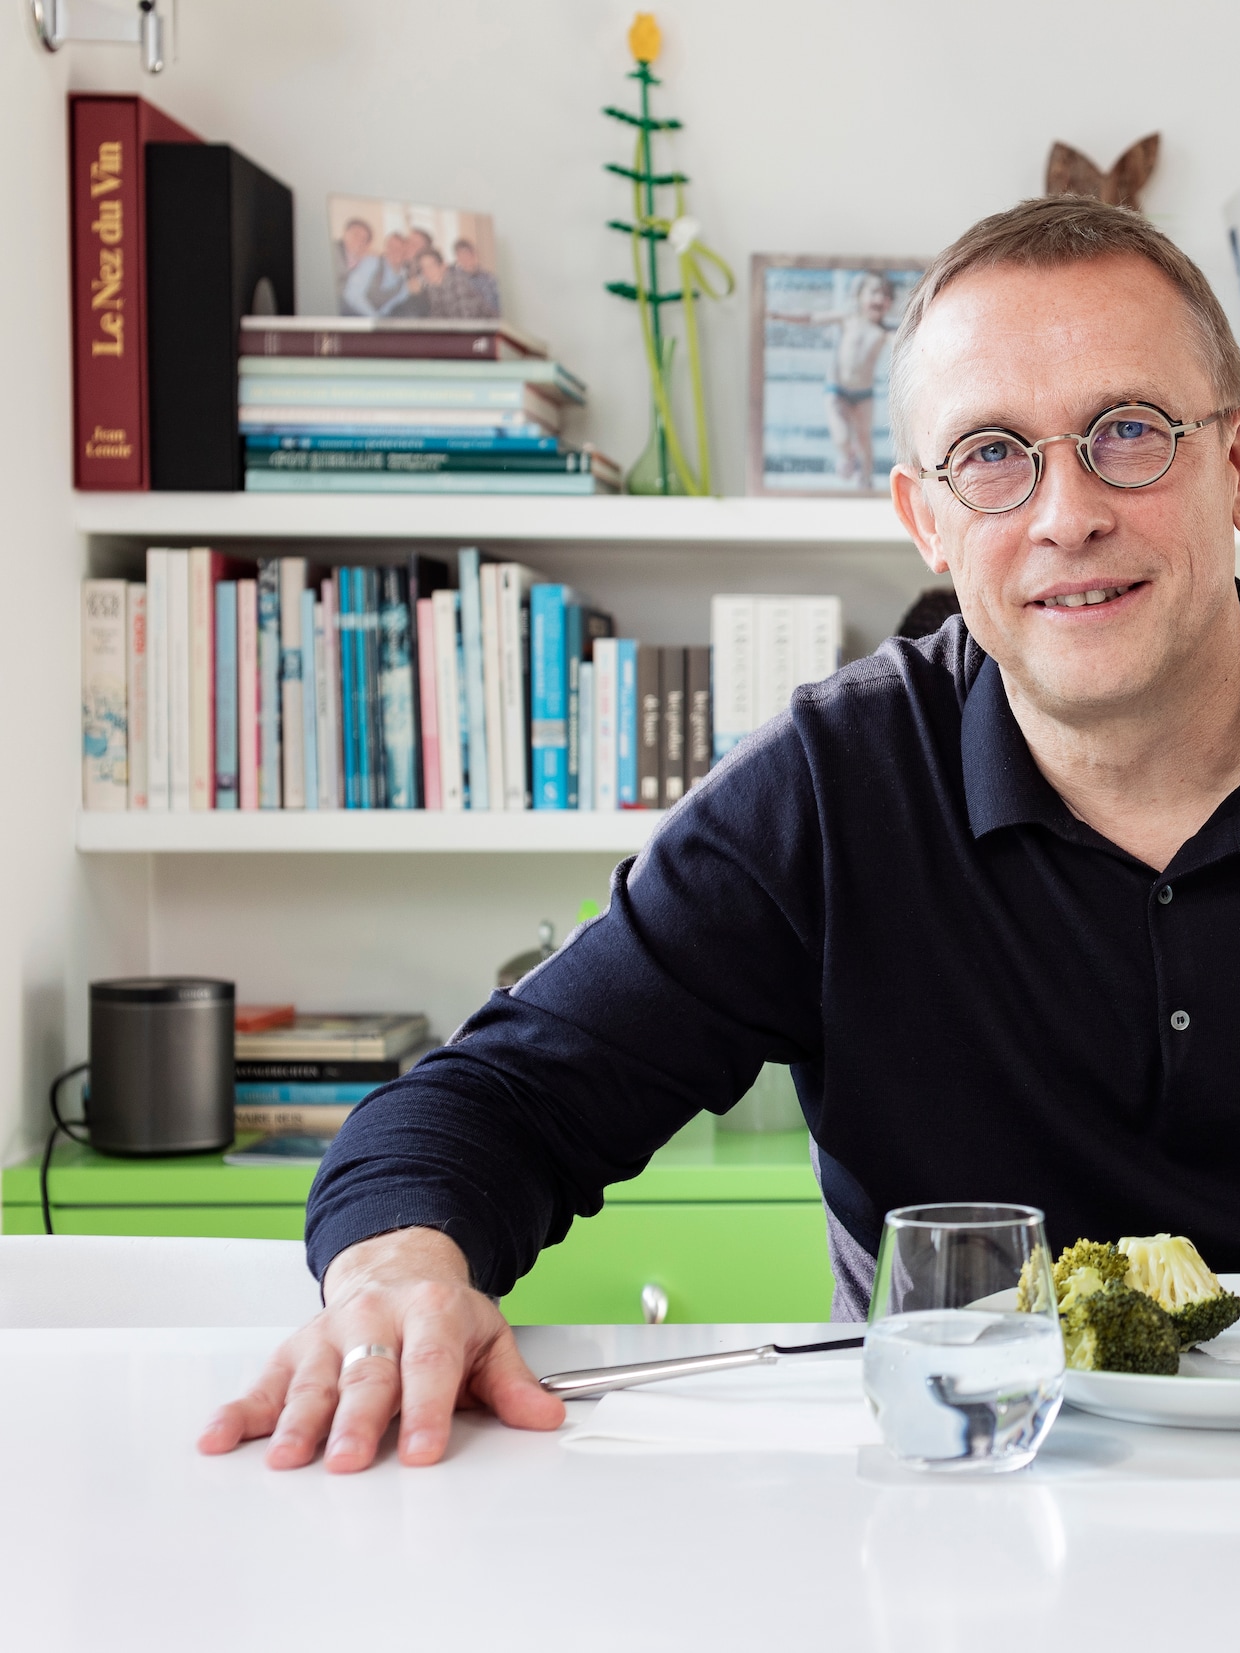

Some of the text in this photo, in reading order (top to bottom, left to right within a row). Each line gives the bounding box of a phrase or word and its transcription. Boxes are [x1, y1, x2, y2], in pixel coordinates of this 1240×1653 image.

[90, 141, 126, 358] Le Nez du Vin
[93, 426, 127, 442] Jean
[86, 440, 132, 459] Lenoir
